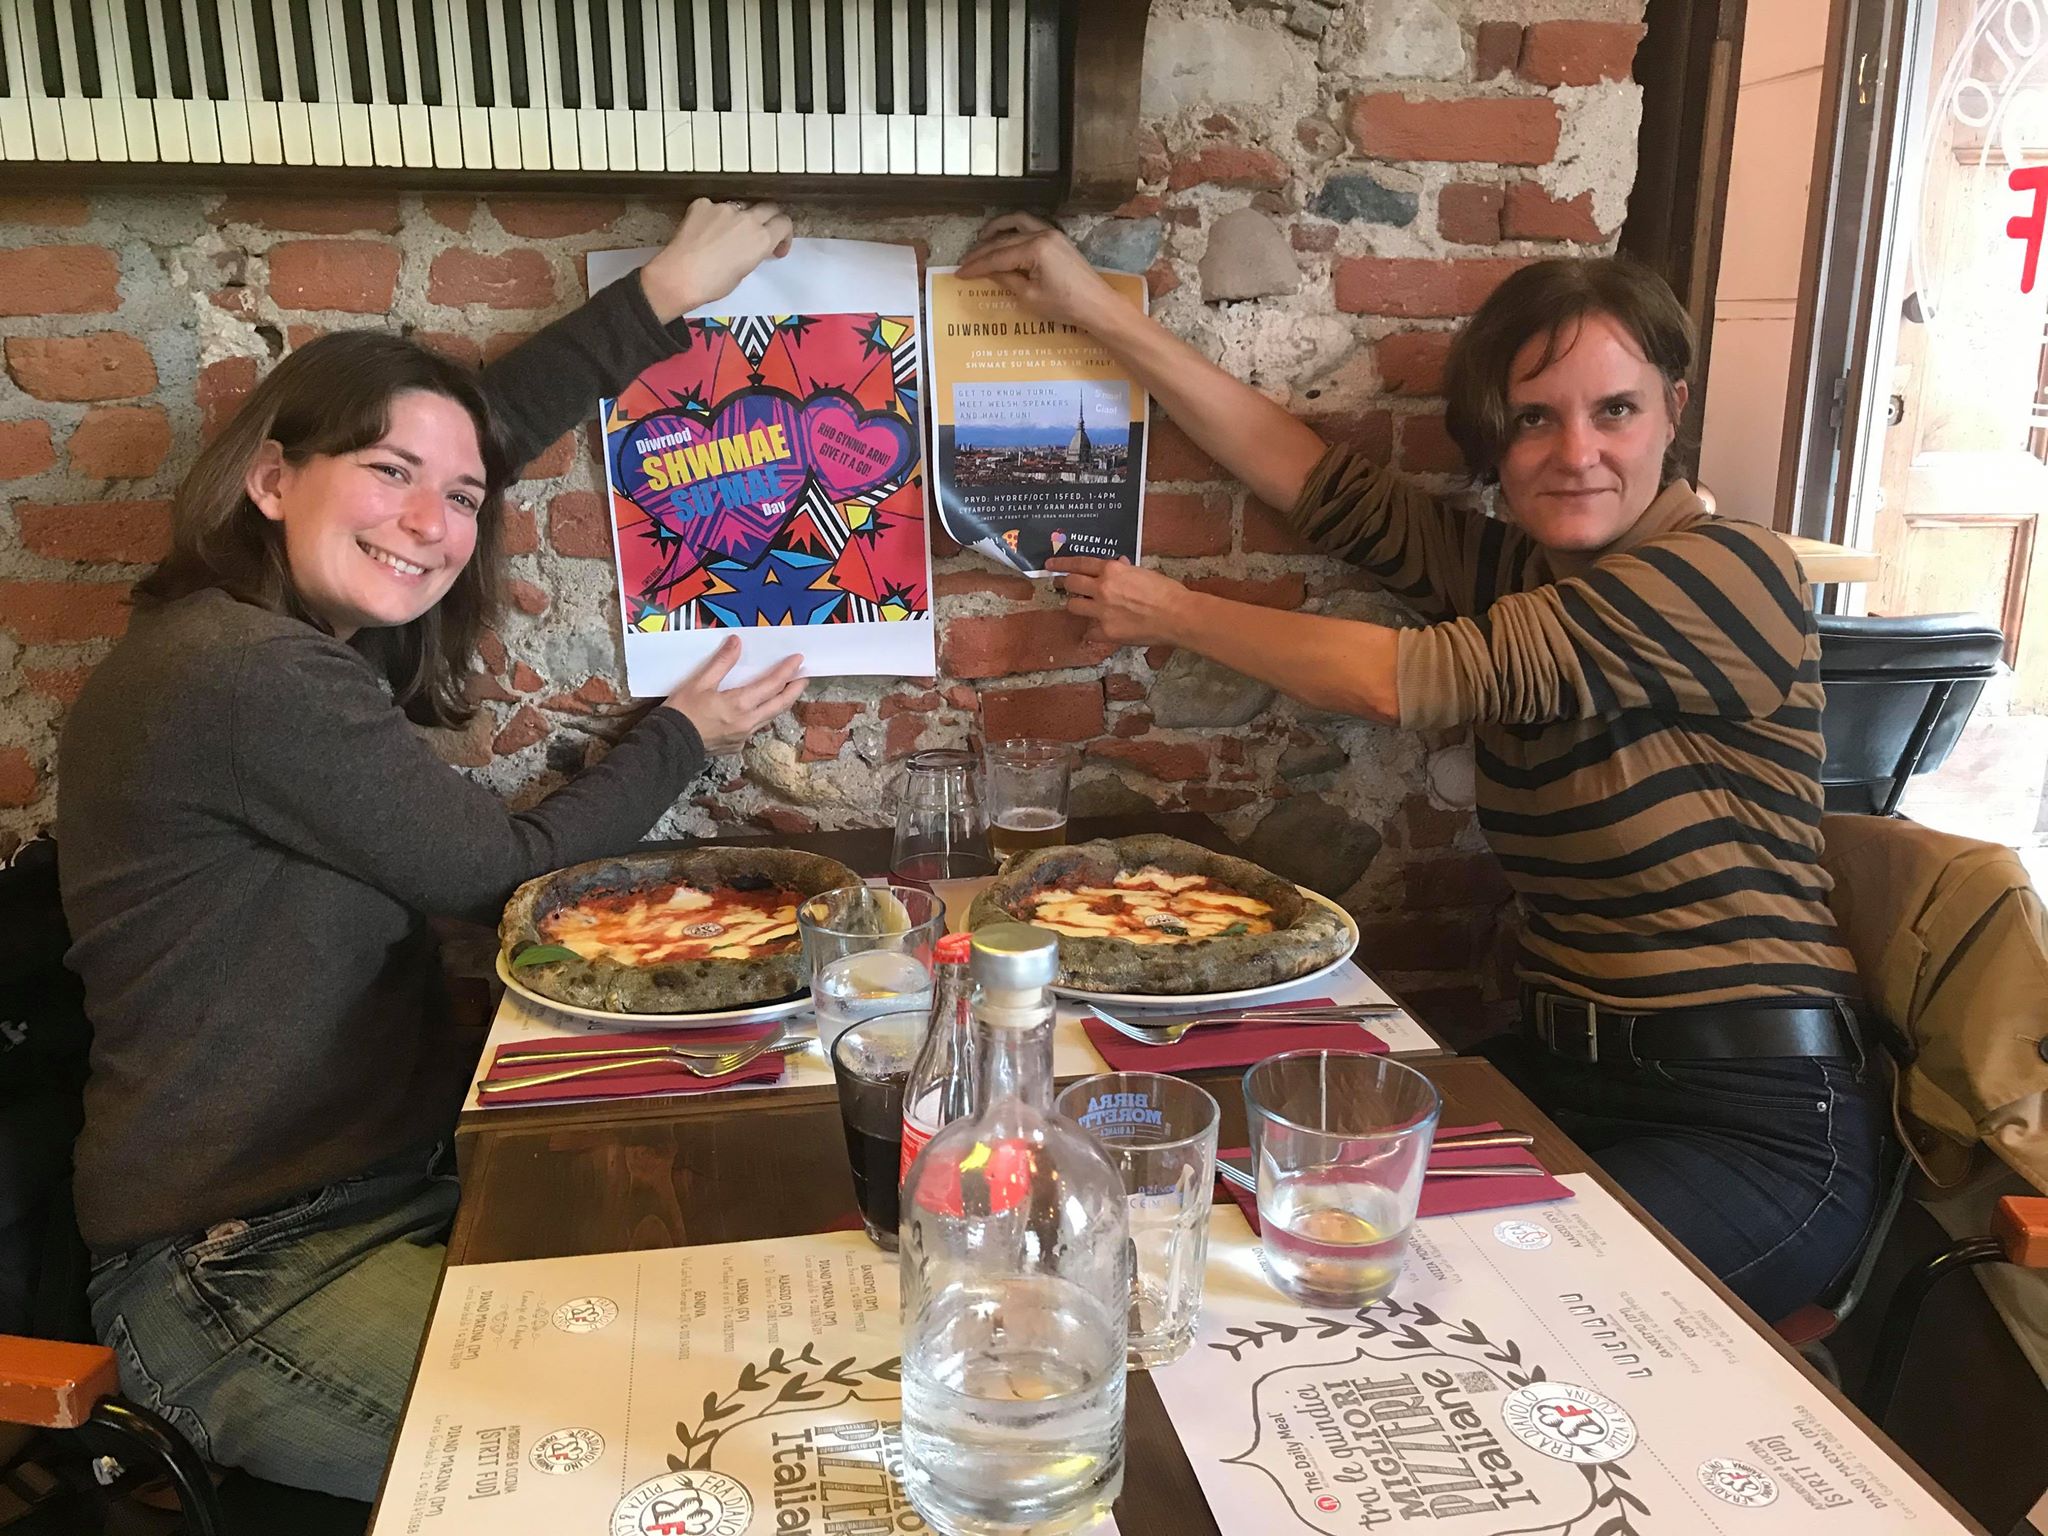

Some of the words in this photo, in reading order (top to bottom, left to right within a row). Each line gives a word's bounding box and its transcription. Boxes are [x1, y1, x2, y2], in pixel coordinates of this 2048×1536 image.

[948, 323, 1007, 336] DIWRNOD
[1014, 321, 1055, 335] ALLAN
[966, 361, 1006, 369] SHWMAE
[1050, 359, 1067, 368] DAY
[971, 350, 993, 358] JOIN
[1036, 348, 1051, 356] THE
[959, 389, 976, 397] GET
[960, 412, 981, 420] AND
[635, 427, 692, 455] Diwrnod
[818, 423, 836, 440] RHO
[836, 432, 867, 455] GYNNIG
[642, 423, 791, 491] SHWMAE
[819, 443, 840, 461] GIVE
[839, 452, 850, 465] IT
[848, 457, 856, 469] A
[856, 461, 872, 477] GO!
[670, 463, 787, 522] SU'MAE
[964, 496, 990, 504] PRYD:
[994, 493, 1049, 502] HYDREF/OCT
[1089, 492, 1116, 500] 1-4PM
[1044, 502, 1065, 510] GRAN
[1068, 502, 1094, 510] MADRE
[1097, 502, 1106, 510] DI
[1109, 502, 1122, 510] DIO
[762, 500, 787, 517] Day
[1069, 545, 1116, 557] (GELATO!)
[1070, 533, 1102, 543] HUFEN
[1104, 535, 1119, 546] IA!
[818, 1259, 832, 1279] DIANO
[1426, 1261, 1447, 1281] NIZZA
[477, 1290, 494, 1313] DIANO
[736, 1278, 749, 1306] ALBENGA
[779, 1274, 792, 1302] ALASSIO
[822, 1281, 836, 1310] MARINA
[694, 1290, 706, 1318] GENOVA
[471, 1313, 489, 1343] MARINA
[822, 1311, 838, 1327] (IM)
[1673, 1317, 1698, 1338] ROMA
[1558, 1292, 1653, 1379] LUCIANO
[463, 1344, 481, 1361] (IM)
[1508, 1389, 1541, 1440] DIAVOLO
[1564, 1388, 1618, 1415] CUCINA
[1269, 1412, 1296, 1440] Meal
[1285, 1382, 1366, 1458] quindici
[1792, 1419, 1820, 1439] (IM)
[442, 1425, 463, 1453] DIANO
[476, 1427, 506, 1467] [STRIT
[1323, 1379, 1432, 1521] MIGLIORI
[1348, 1371, 1501, 1520] PIZZERIE
[1420, 1368, 1542, 1509] Italiane
[1538, 1437, 1575, 1459] FRA
[1604, 1425, 1631, 1451] PIZZA
[1758, 1434, 1801, 1462] FUD]
[1285, 1441, 1311, 1470] Daily
[1815, 1440, 1855, 1477] MARINA
[433, 1454, 455, 1494] MARINA
[468, 1471, 500, 1500] FUD]
[772, 1428, 817, 1536] Italia
[1303, 1470, 1324, 1494] The
[1332, 1461, 1368, 1483] le
[623, 1482, 664, 1511] PIZZA
[699, 1474, 735, 1499] FRA
[1792, 1465, 1854, 1509] [STRIT
[1850, 1478, 1888, 1509] DIANO
[424, 1496, 447, 1518] (IM)
[1355, 1486, 1393, 1531] tra
